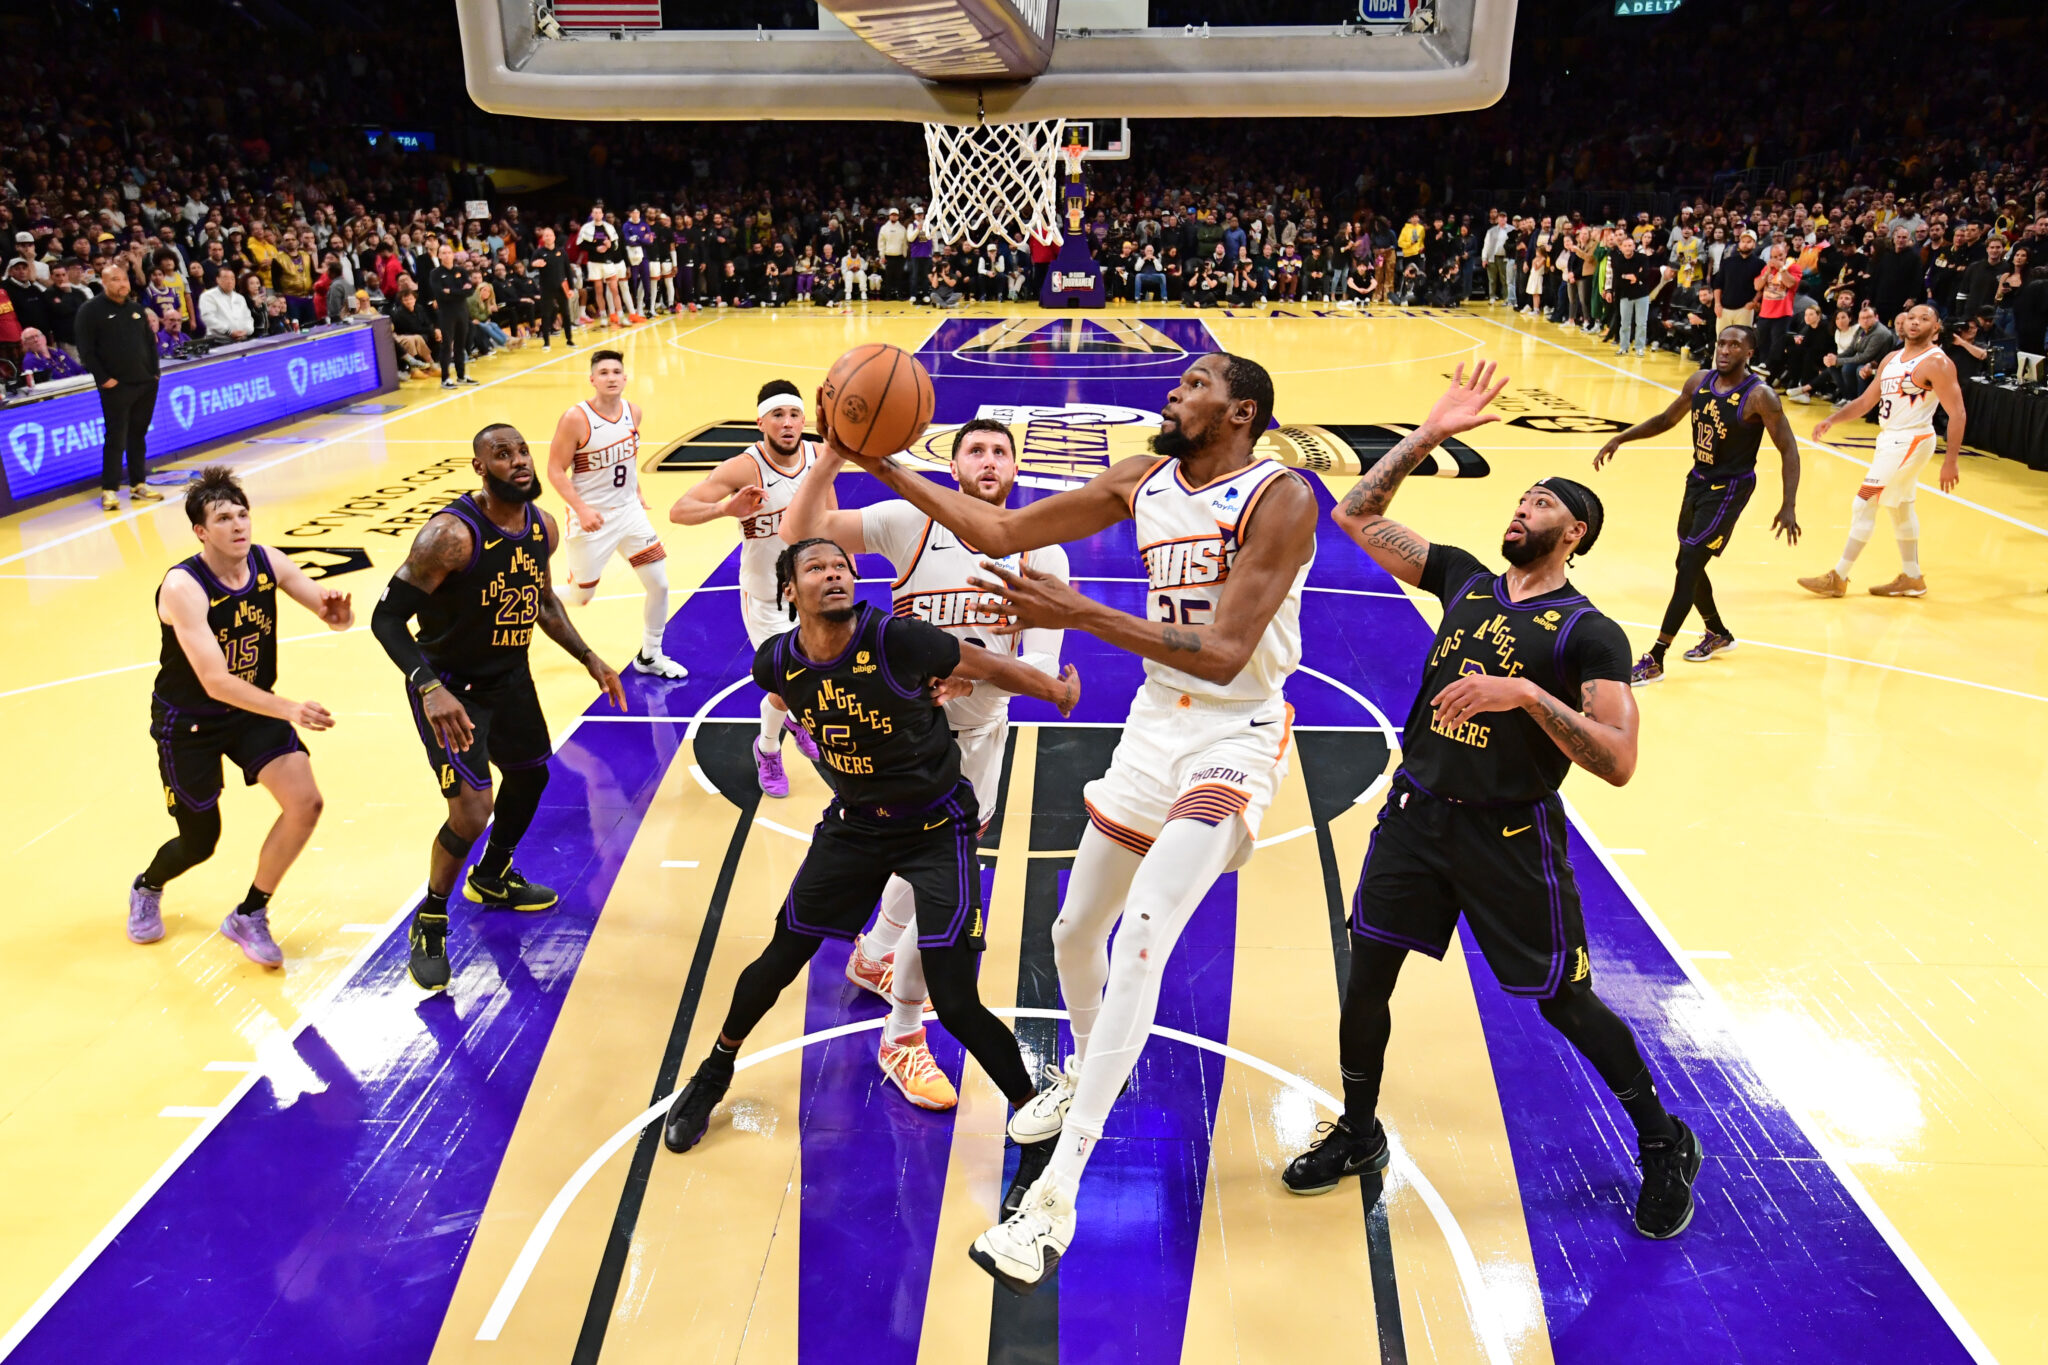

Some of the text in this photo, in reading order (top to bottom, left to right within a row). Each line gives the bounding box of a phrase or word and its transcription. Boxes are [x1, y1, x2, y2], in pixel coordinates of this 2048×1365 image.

[311, 352, 370, 385] FANDUEL
[200, 375, 277, 417] FANDUEL
[1880, 378, 1900, 396] UNS
[1697, 421, 1714, 451] 12
[587, 437, 635, 471] SUNS
[613, 465, 627, 488] 8
[481, 546, 545, 607] LOS ANGELE
[1146, 539, 1222, 590] SUNS
[496, 585, 539, 625] 23
[912, 591, 1003, 626] SUNS
[491, 628, 534, 647] LAKER
[1532, 615, 1558, 631] bibigo
[225, 632, 260, 673] 15
[1473, 613, 1525, 678] ANGELE
[852, 663, 877, 674] bibigo
[801, 679, 892, 735] OS ANGELES
[1188, 767, 1248, 786] PHOENIX
